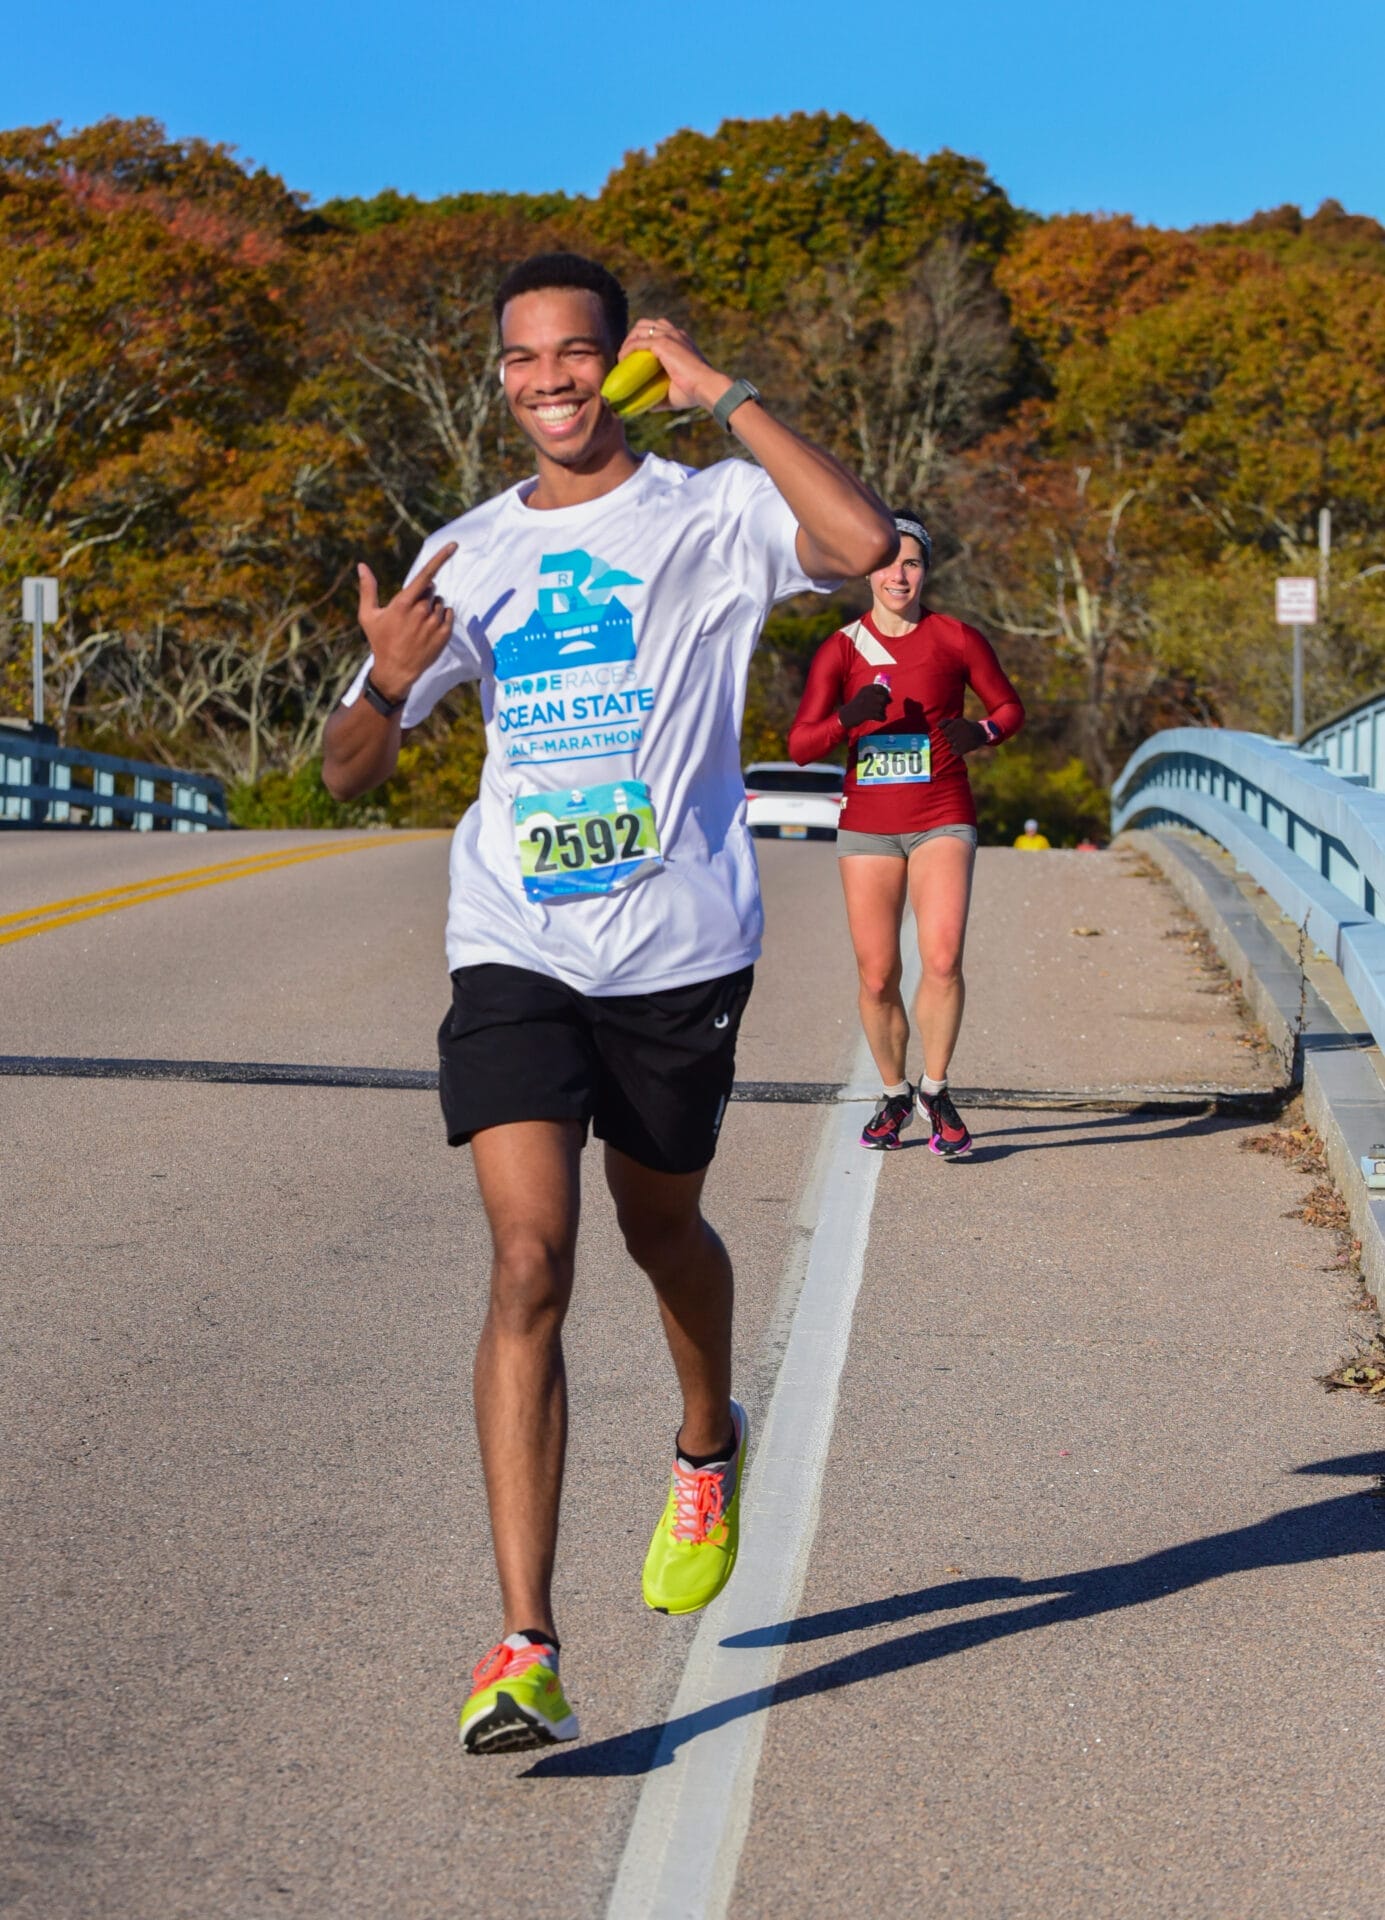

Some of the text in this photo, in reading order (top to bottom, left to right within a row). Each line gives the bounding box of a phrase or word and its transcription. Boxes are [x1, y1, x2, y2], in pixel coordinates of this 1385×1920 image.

[557, 573, 569, 586] R
[498, 687, 655, 733] OCEAN STATE
[863, 751, 923, 777] 2360
[530, 813, 645, 873] 2592
